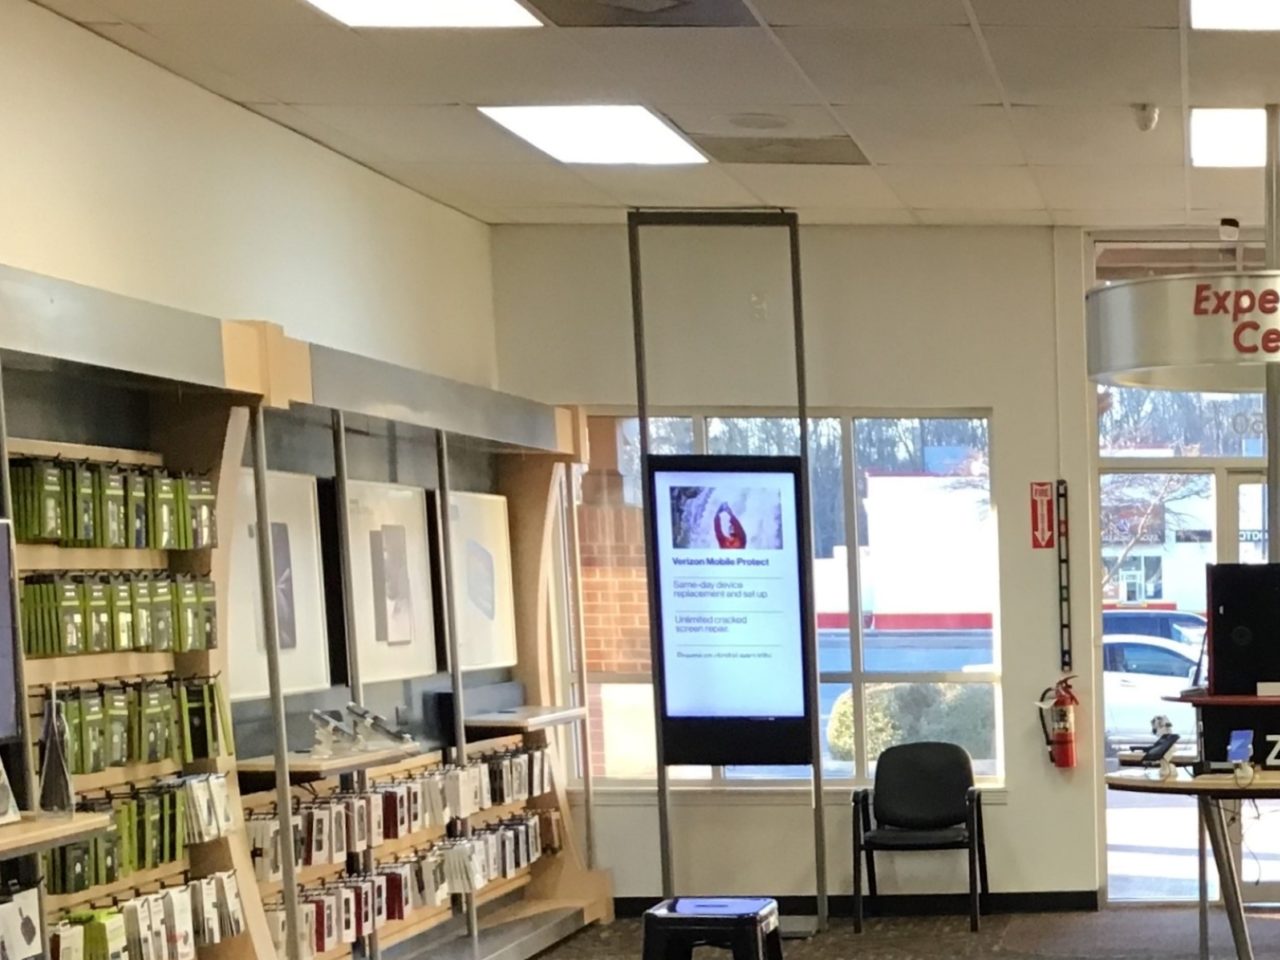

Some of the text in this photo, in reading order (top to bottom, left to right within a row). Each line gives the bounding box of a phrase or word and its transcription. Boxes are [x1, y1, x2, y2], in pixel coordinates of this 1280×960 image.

[672, 557, 770, 566] Verizon Mobile Protect
[673, 580, 743, 589] Same-day device
[673, 590, 725, 598] replacement
[726, 590, 742, 598] and
[675, 616, 747, 624] Unlimited cracked
